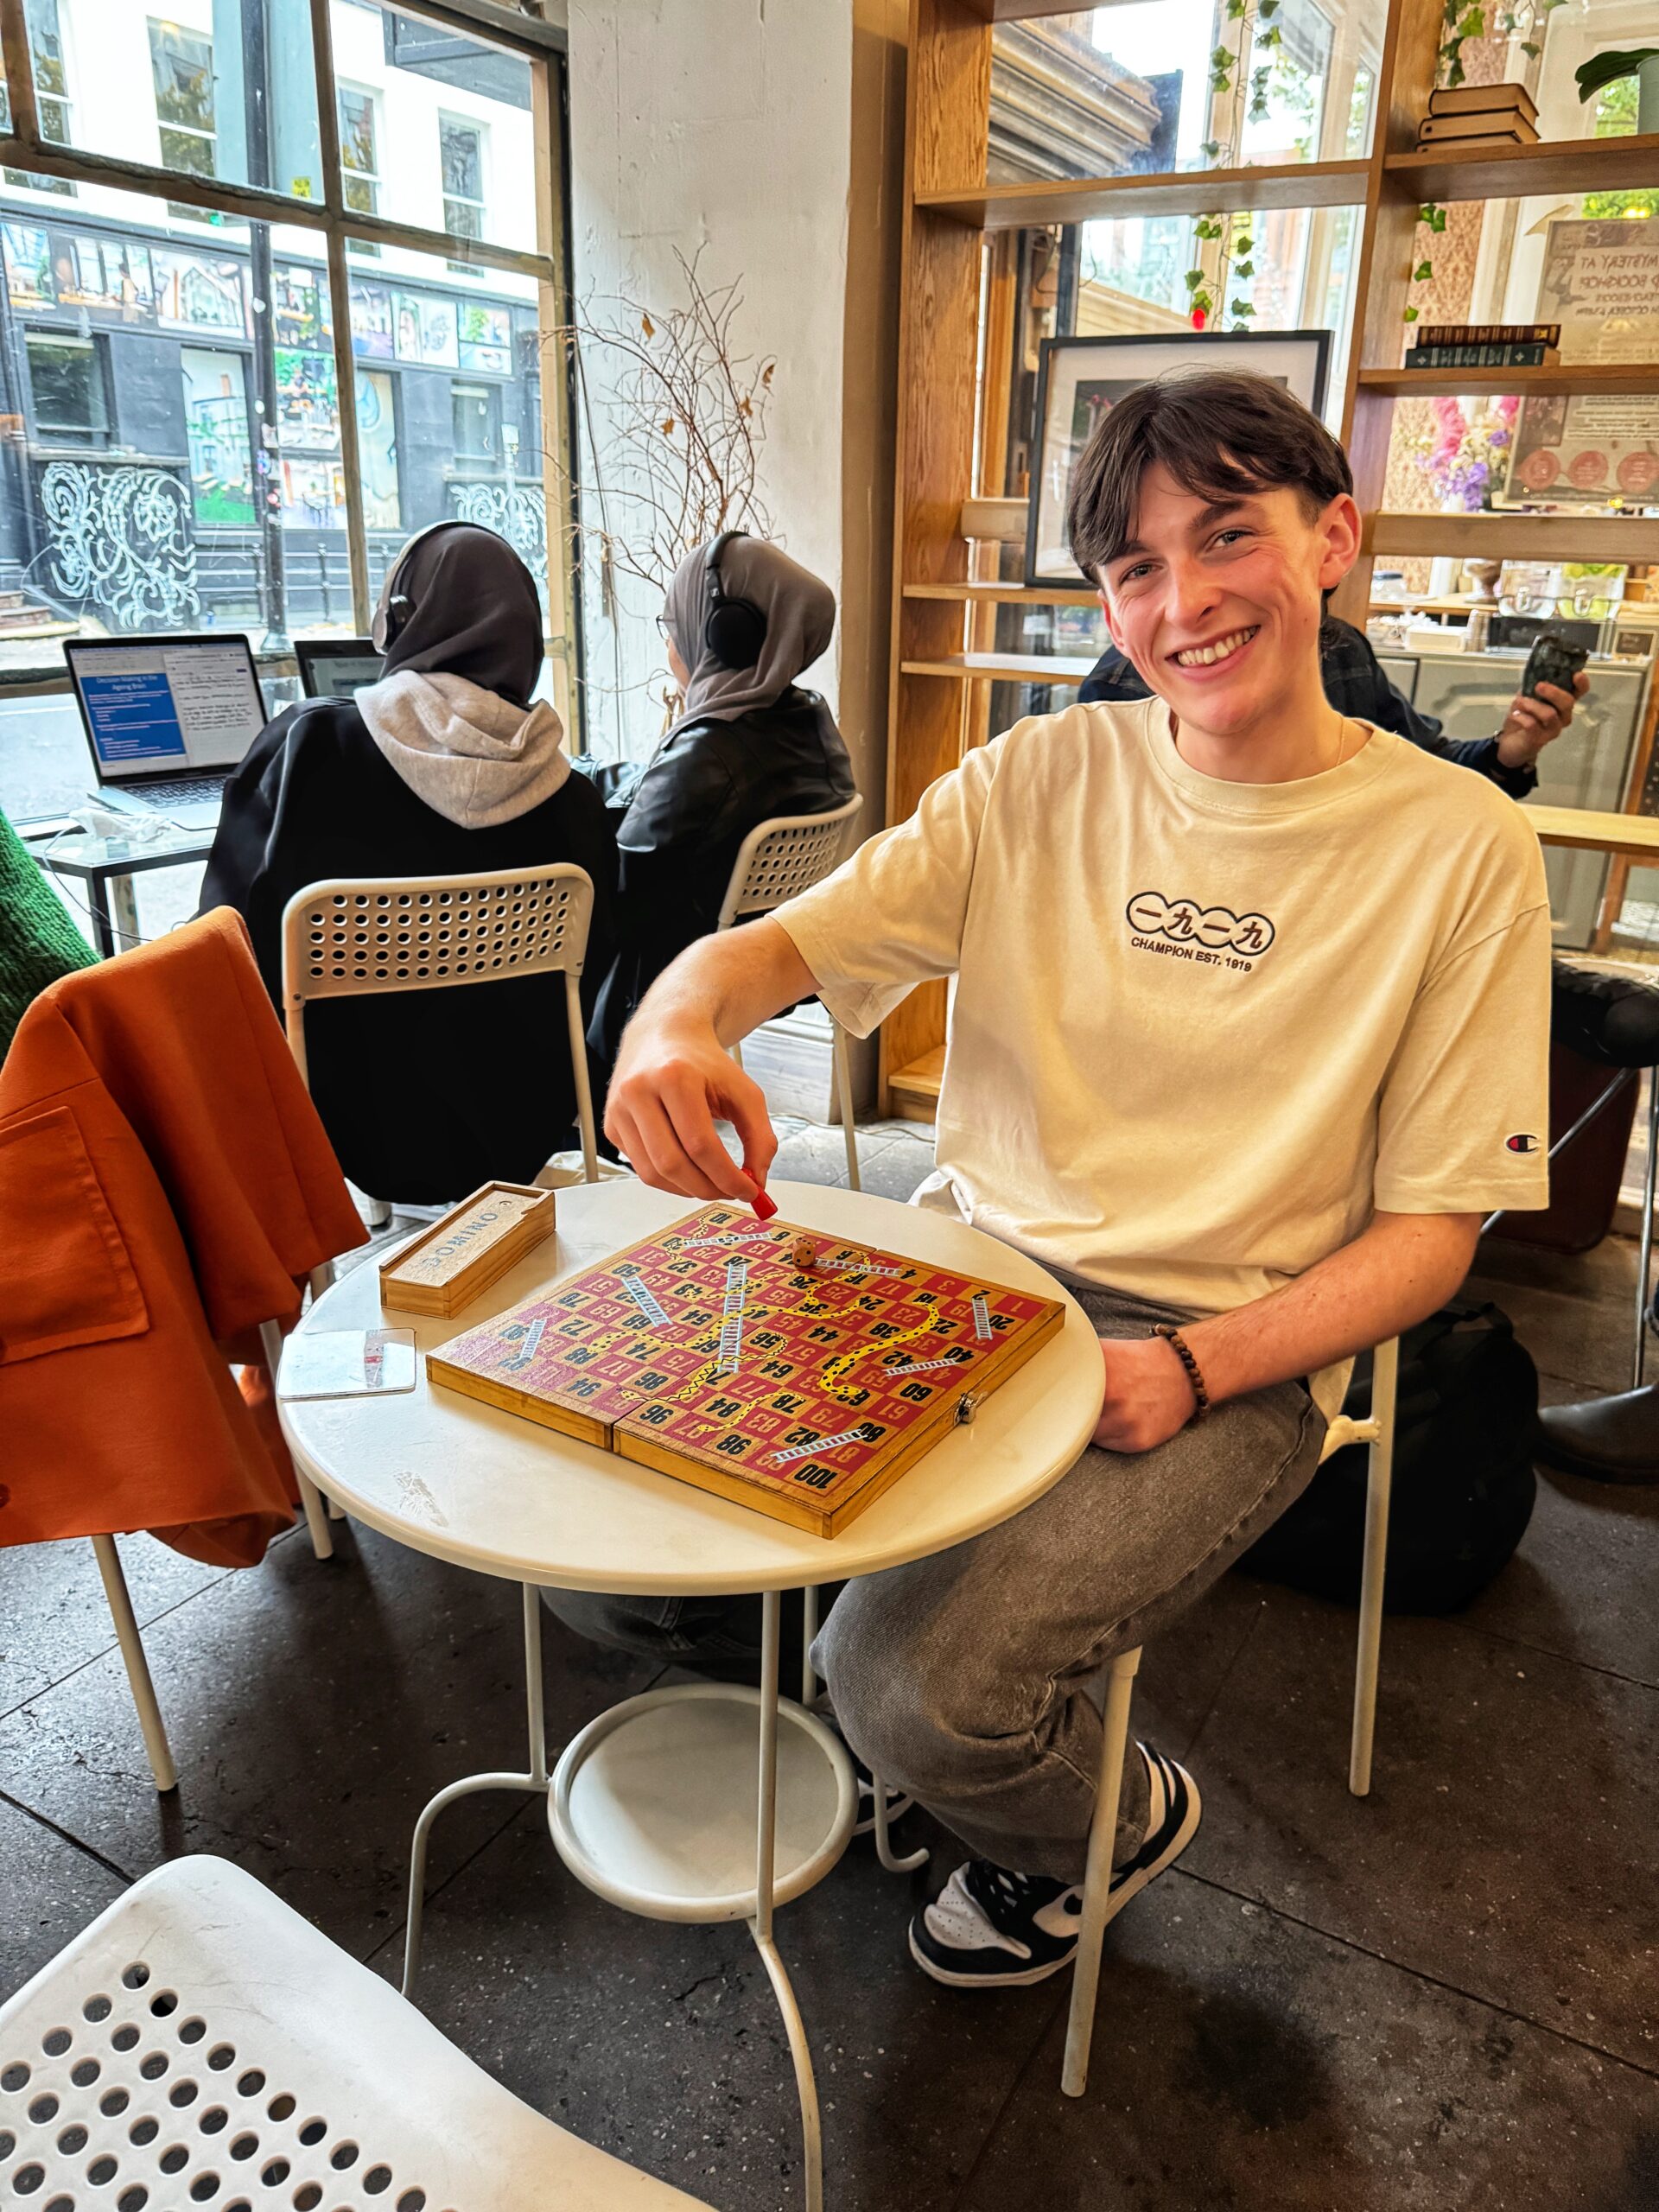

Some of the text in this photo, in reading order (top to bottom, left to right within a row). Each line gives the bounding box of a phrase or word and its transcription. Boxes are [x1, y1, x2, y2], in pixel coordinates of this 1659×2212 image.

[1134, 906, 1264, 950] 一九一九
[1130, 937, 1252, 973] CHAMPION EST. 1919
[639, 1250, 665, 1262] 31
[692, 1247, 722, 1259] 29
[747, 1243, 772, 1255] 13
[667, 1260, 697, 1273] 32
[723, 1255, 753, 1267] 28
[612, 1263, 642, 1278] 50
[900, 1269, 918, 1279] 4
[584, 1278, 613, 1293] 51
[643, 1274, 671, 1287] 49
[788, 1276, 818, 1289] 26
[875, 1282, 901, 1295] 17
[937, 1280, 956, 1291] 3
[557, 1292, 590, 1308] 70
[765, 1290, 795, 1303] 35
[822, 1286, 851, 1300] 25
[590, 1303, 621, 1319] 69
[858, 1295, 886, 1311] 24
[950, 1304, 974, 1318] 19
[1010, 1300, 1024, 1313] 1
[680, 1309, 713, 1325] 54
[774, 1315, 804, 1330] 45
[891, 1307, 922, 1322] 23
[988, 1314, 1015, 1330] 20
[559, 1319, 593, 1336] 72
[655, 1325, 688, 1341] 67
[808, 1325, 839, 1342] 44
[869, 1323, 900, 1338] 38
[749, 1332, 780, 1349] 56
[626, 1342, 661, 1360] 74
[782, 1344, 816, 1361] 57
[882, 1351, 914, 1368] 42
[944, 1346, 975, 1363] 40
[597, 1360, 632, 1377] 87
[662, 1354, 696, 1372] 75
[760, 1360, 794, 1378] 64
[567, 1377, 601, 1397] 94
[634, 1372, 669, 1390] 86
[861, 1370, 891, 1387] 59
[731, 1380, 767, 1399] 77
[899, 1382, 933, 1402] 60
[705, 1397, 741, 1418] 84
[772, 1394, 806, 1414] 78
[878, 1402, 909, 1420] 61
[639, 1405, 674, 1424] 96
[746, 1413, 782, 1433] 83
[810, 1408, 845, 1427] 79
[716, 1433, 752, 1455] 98
[785, 1427, 821, 1446] 82
[827, 1445, 860, 1463] 81
[794, 1464, 838, 1489] 100
